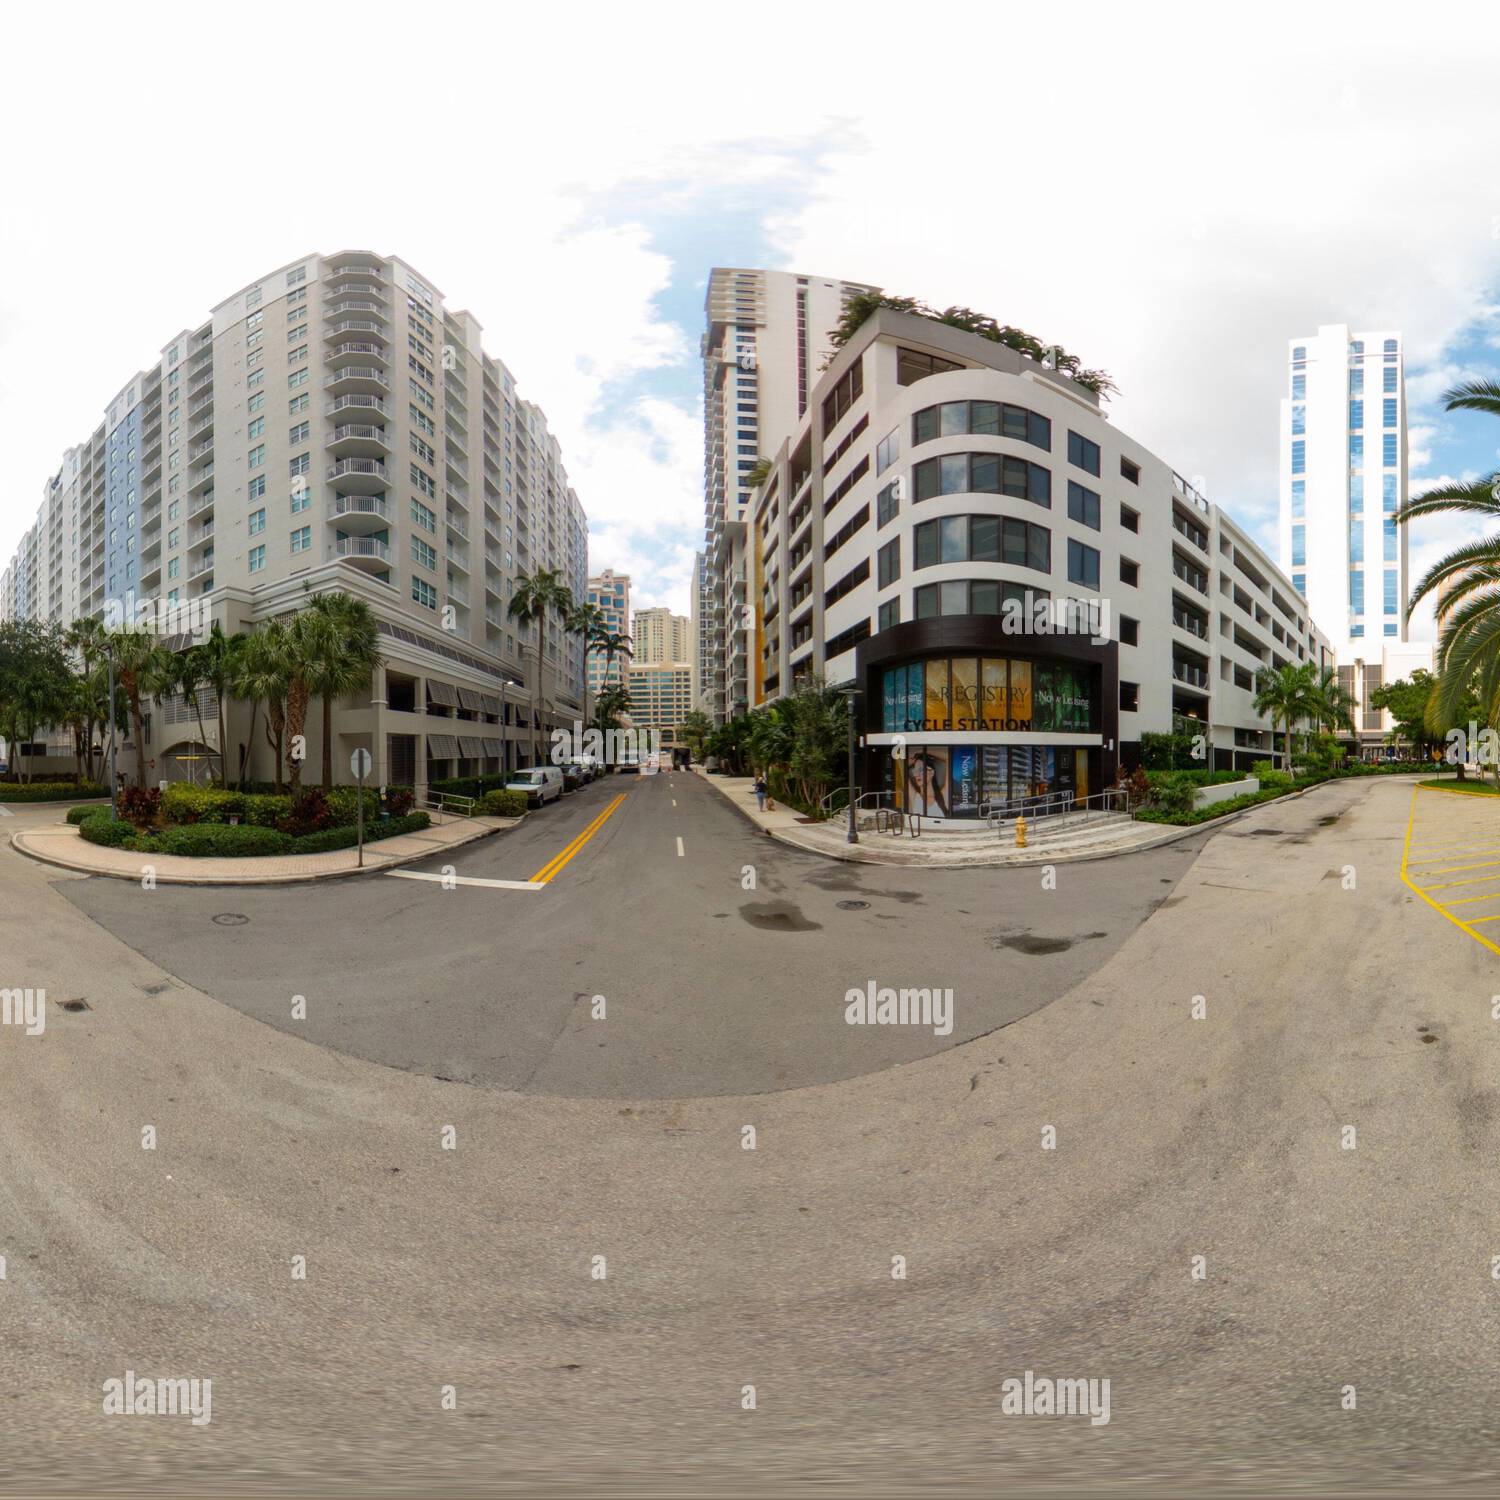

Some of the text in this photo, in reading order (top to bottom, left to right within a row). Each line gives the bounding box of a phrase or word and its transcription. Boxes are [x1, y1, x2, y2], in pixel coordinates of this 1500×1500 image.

[940, 686, 1028, 703] REGISTRY
[1038, 689, 1062, 705] Now
[903, 718, 953, 732] CYCLE
[957, 718, 1032, 732] STATION
[960, 755, 972, 809] Now Leasing
